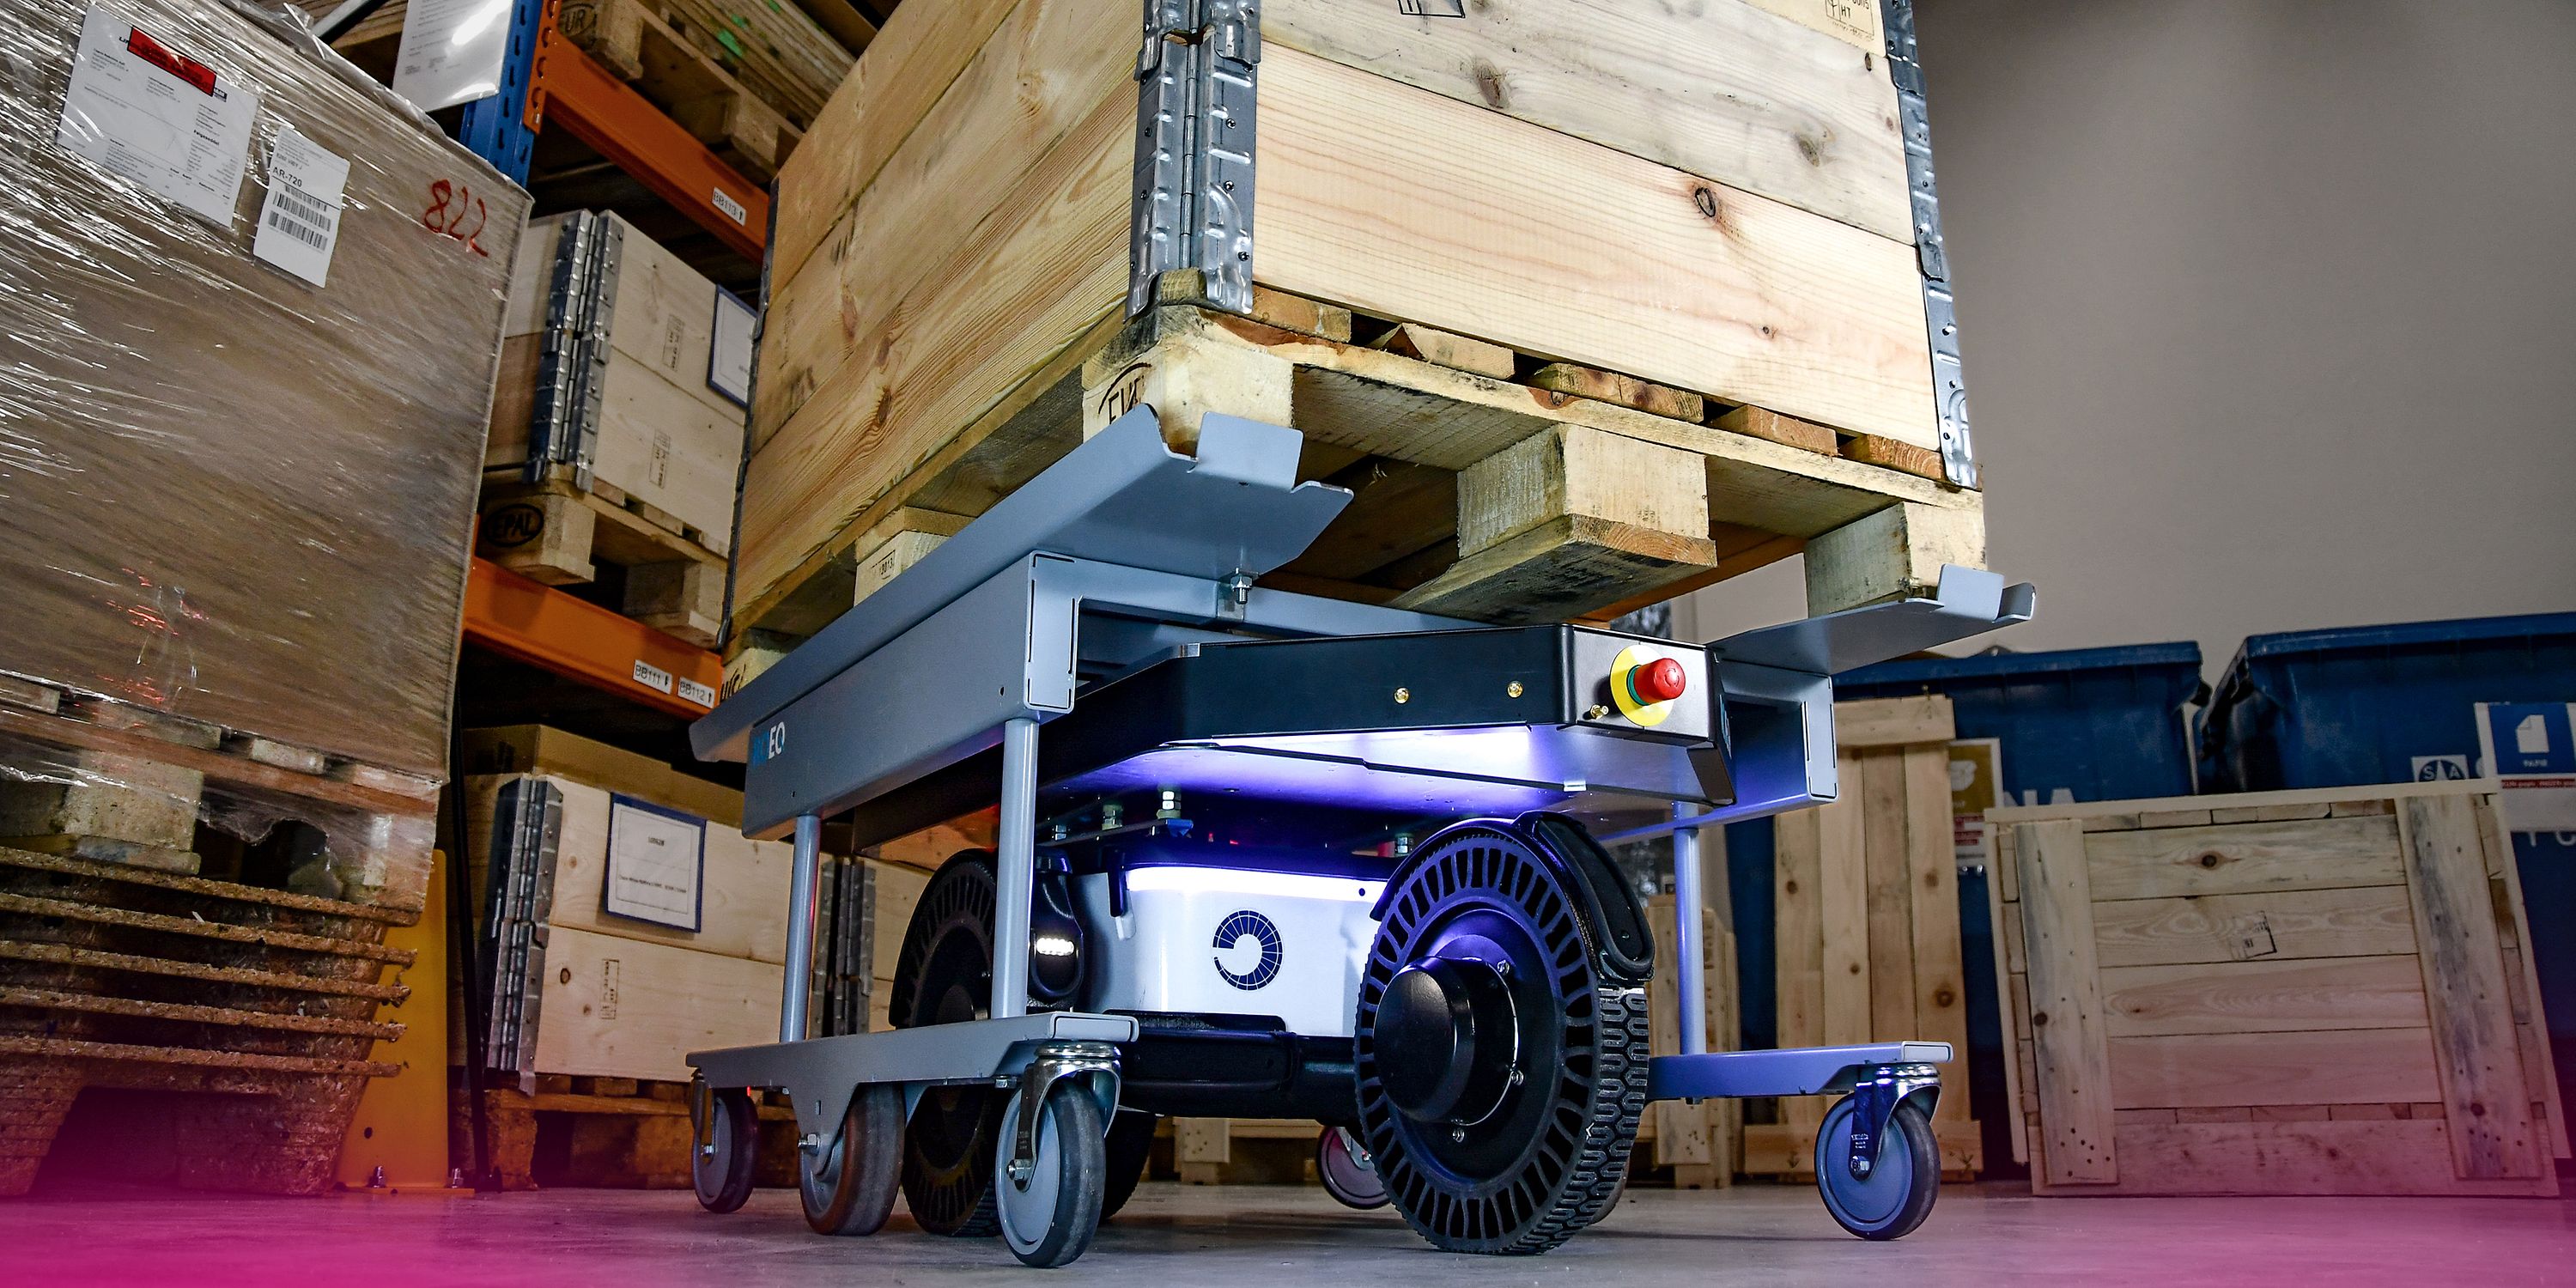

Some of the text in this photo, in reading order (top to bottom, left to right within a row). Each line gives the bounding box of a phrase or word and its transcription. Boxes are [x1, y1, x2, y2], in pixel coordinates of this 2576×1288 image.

[1840, 4, 1851, 19] HT
[272, 167, 302, 187] AR-720
[424, 178, 489, 258] 822
